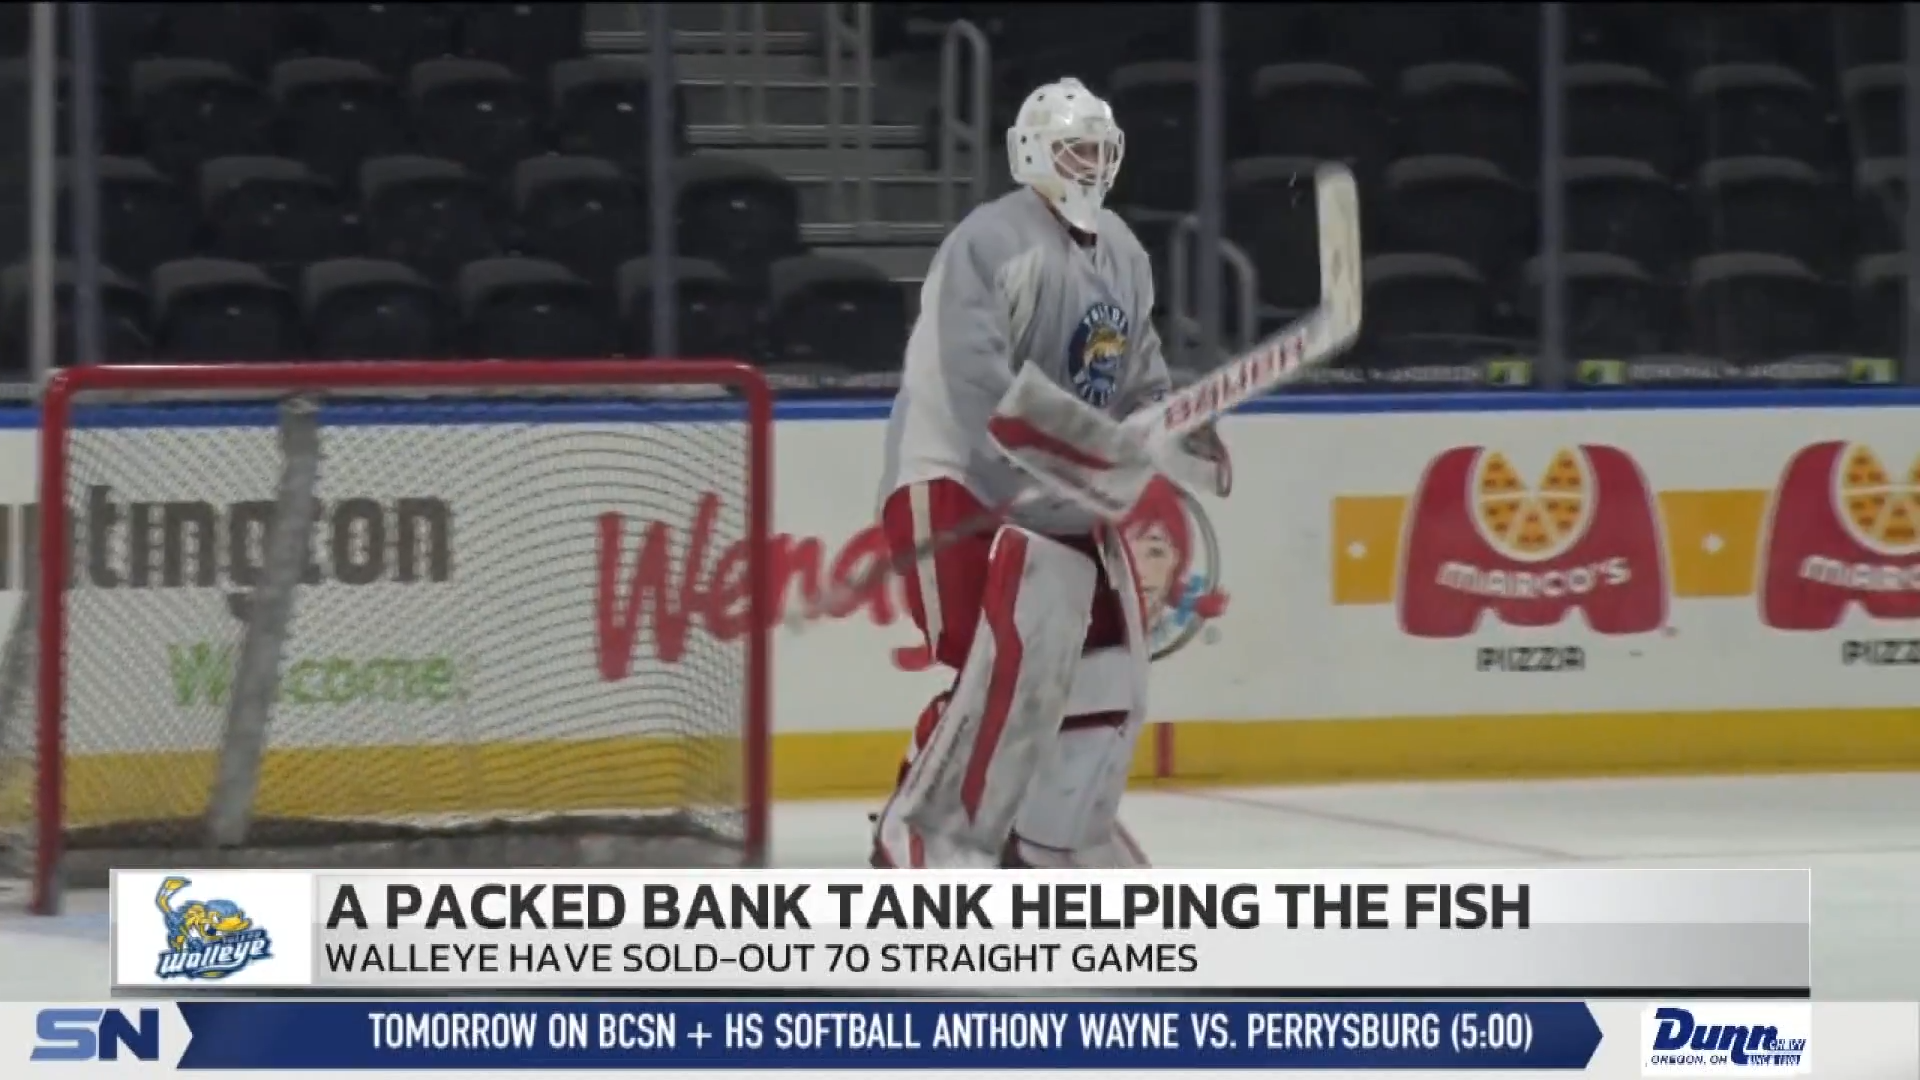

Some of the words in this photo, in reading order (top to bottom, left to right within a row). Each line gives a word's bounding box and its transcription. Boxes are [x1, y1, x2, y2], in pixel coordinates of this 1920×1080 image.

[1435, 556, 1632, 598] MARCO'S
[1476, 645, 1586, 672] PIZZA
[1842, 638, 1920, 666] PIZZ
[167, 640, 456, 706] Wcome
